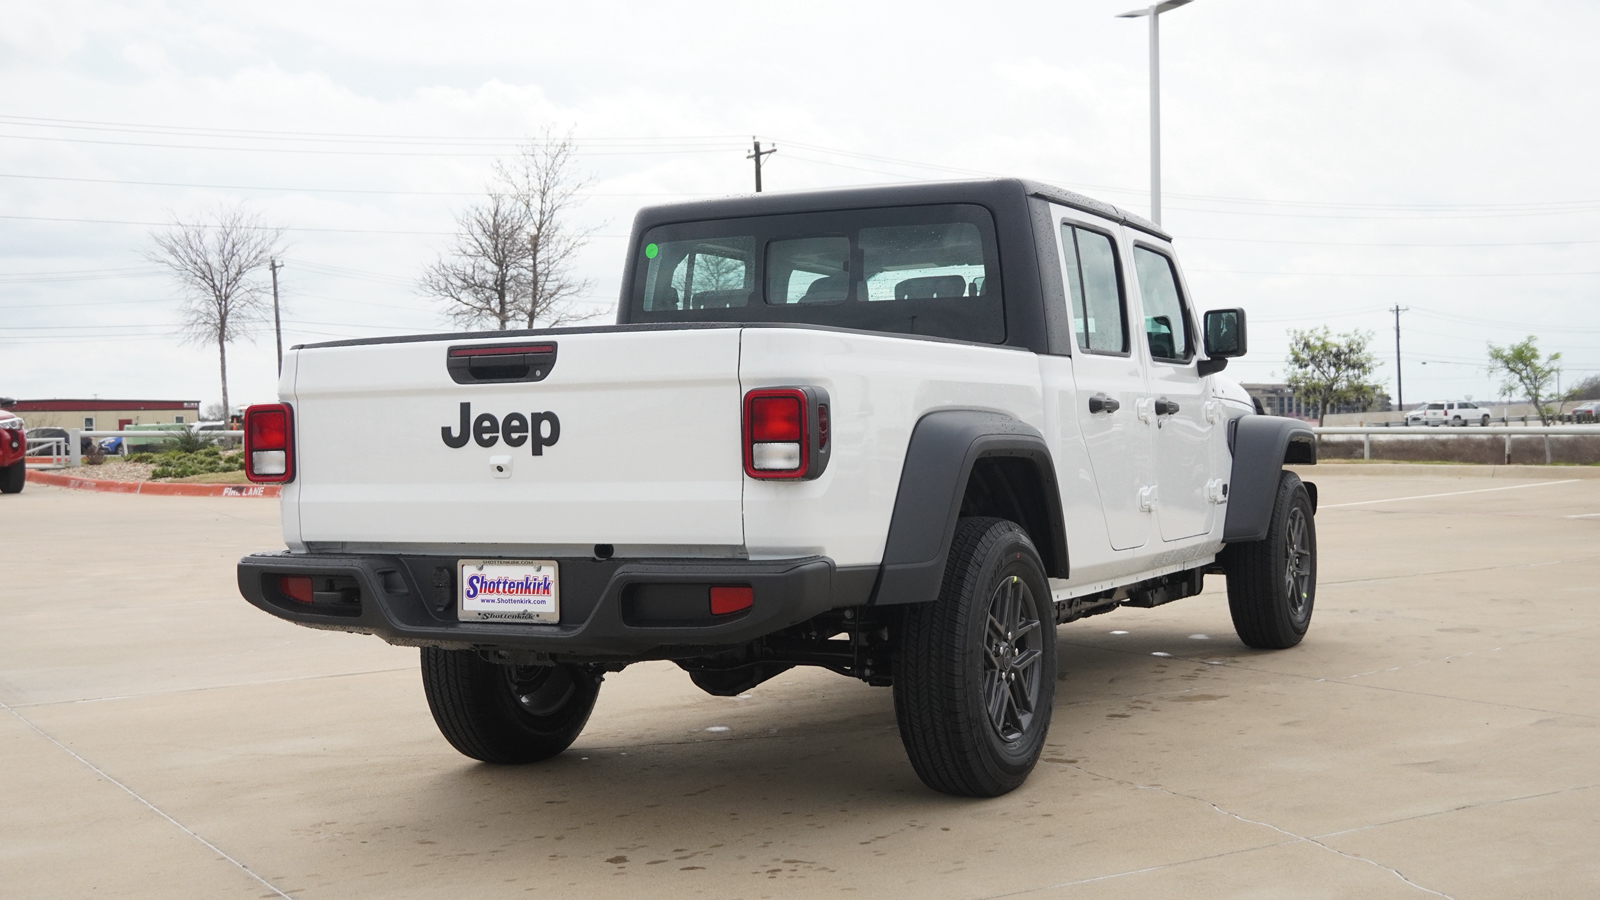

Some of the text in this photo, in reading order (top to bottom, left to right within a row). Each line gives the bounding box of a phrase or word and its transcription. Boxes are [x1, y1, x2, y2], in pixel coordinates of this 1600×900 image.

[441, 402, 561, 456] Jeep
[242, 487, 264, 496] LANE
[466, 574, 553, 600] Shottenkirk
